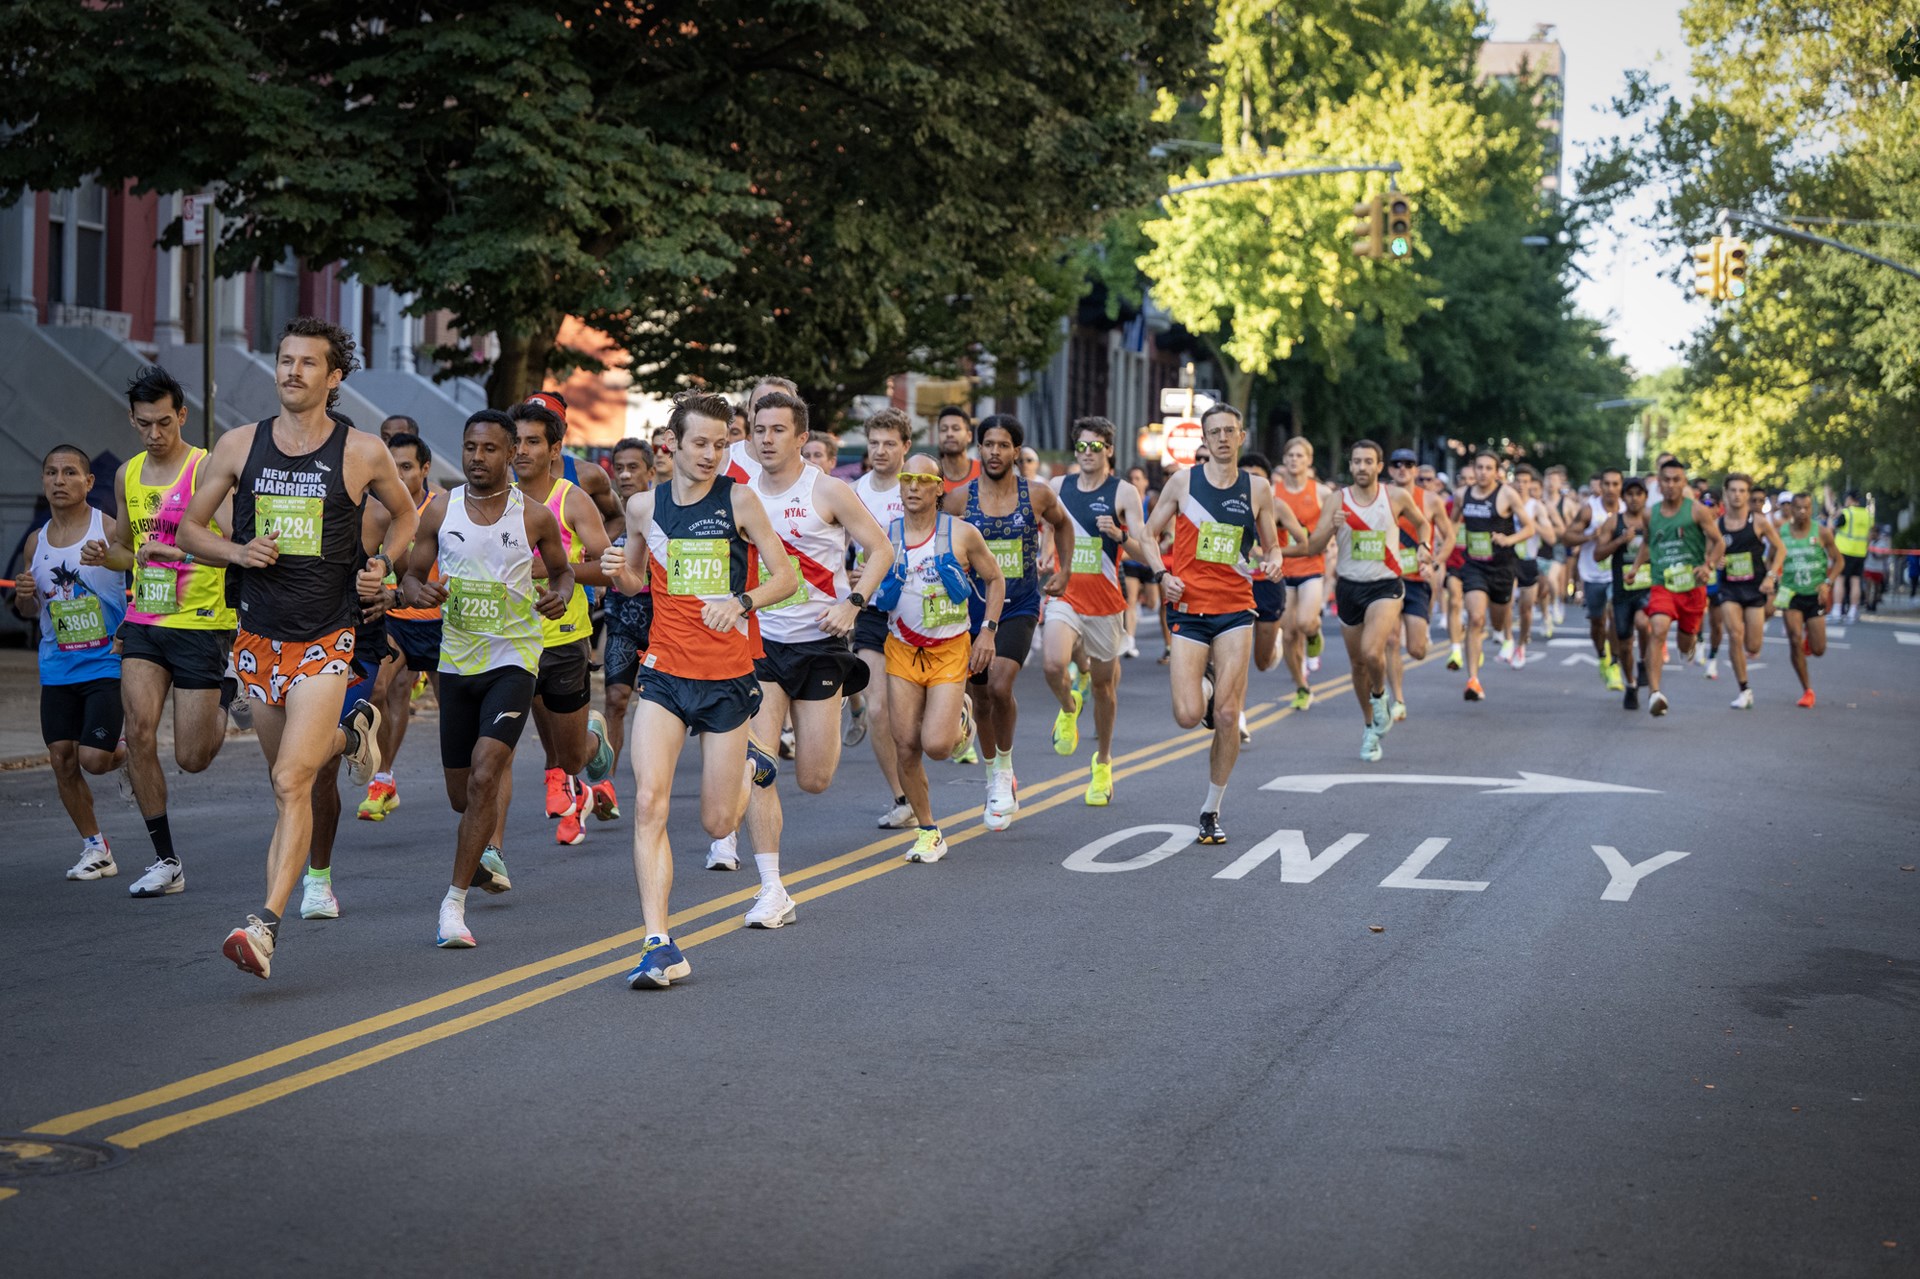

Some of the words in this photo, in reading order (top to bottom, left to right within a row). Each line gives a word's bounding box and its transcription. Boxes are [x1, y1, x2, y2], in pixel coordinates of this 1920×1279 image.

[262, 467, 289, 481] NEW
[292, 471, 323, 483] YORK
[254, 478, 327, 497] HARRIERS
[784, 507, 807, 519] NYAC
[138, 518, 162, 533] MEXICAN
[162, 518, 179, 536] RUNN
[264, 519, 271, 527] A
[272, 516, 315, 539] 4284
[688, 519, 715, 532] CENTRAL
[715, 519, 731, 530] PARK
[1213, 536, 1235, 554] 556
[674, 559, 680, 568] A
[996, 553, 1019, 568] 084
[674, 568, 680, 576] A
[683, 558, 723, 580] 3479
[453, 595, 459, 604] A
[453, 603, 459, 612] A
[460, 597, 499, 619] 2285
[1062, 822, 1692, 902] ONLY
